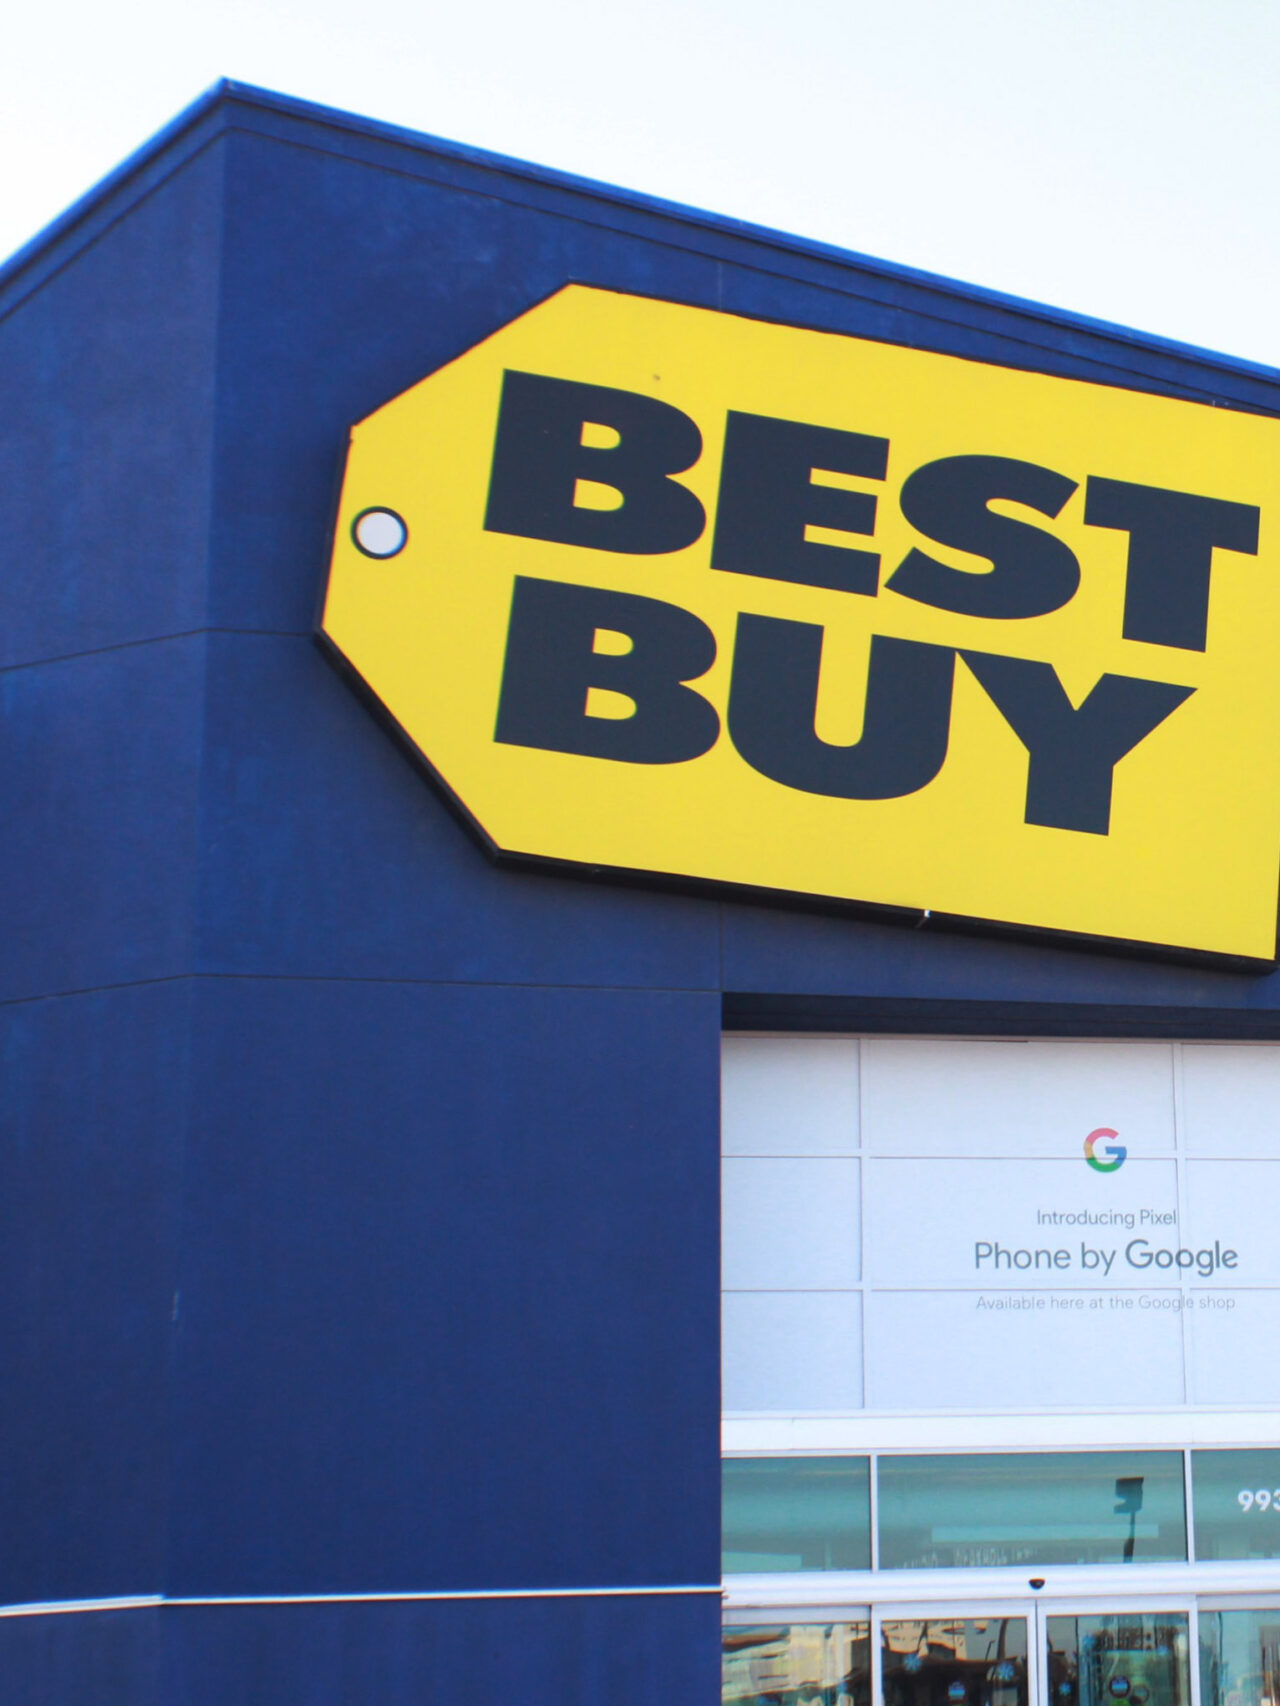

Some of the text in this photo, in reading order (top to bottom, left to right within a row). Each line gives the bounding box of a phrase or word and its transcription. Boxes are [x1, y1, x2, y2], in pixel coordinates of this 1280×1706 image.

[483, 367, 1261, 654] BEST
[493, 574, 1199, 837] BUY
[1083, 1127, 1127, 1173] G
[1036, 1209, 1177, 1229] Introducing Pixel
[974, 1239, 1239, 1278] Phone by Google
[976, 1295, 1236, 1313] Available here at the Google shop
